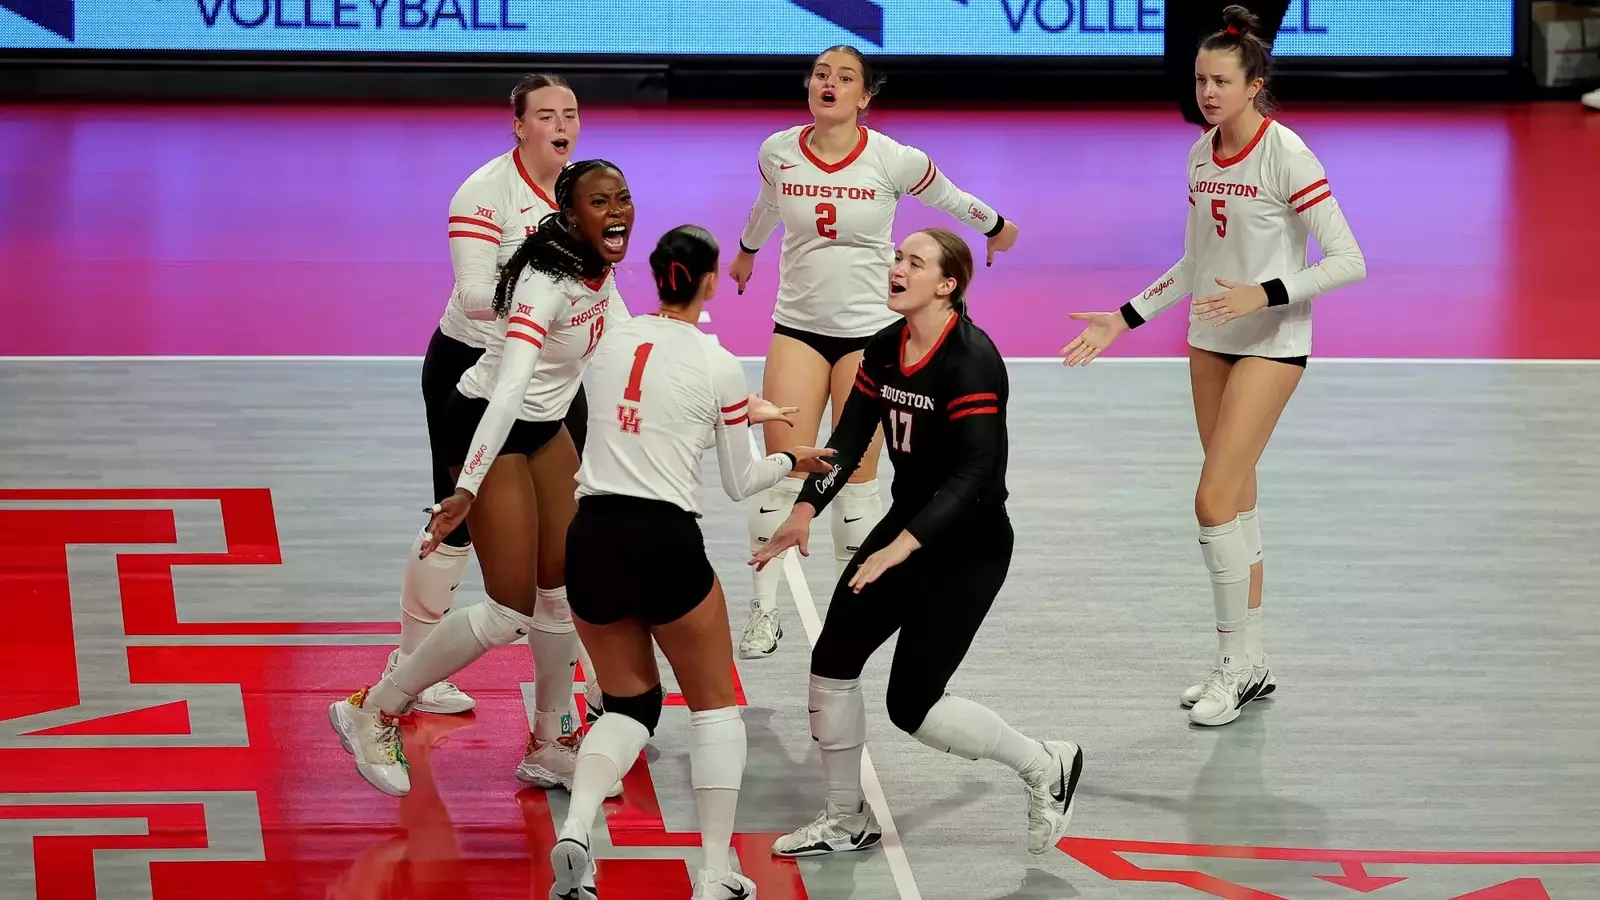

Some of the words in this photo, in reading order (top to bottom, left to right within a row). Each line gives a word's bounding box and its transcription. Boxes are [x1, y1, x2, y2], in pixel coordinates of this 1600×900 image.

[198, 0, 526, 30] VOLLEYBALL
[781, 182, 876, 200] HOUSTON
[474, 205, 496, 220] XII
[815, 202, 838, 240] 2
[1211, 199, 1228, 239] 5
[1143, 277, 1175, 300] Cougars
[515, 302, 534, 317] XII
[571, 297, 611, 327] HOUST
[623, 342, 654, 403] 1
[616, 404, 643, 435] UH
[889, 409, 914, 454] 17
[464, 443, 488, 475] Cougars
